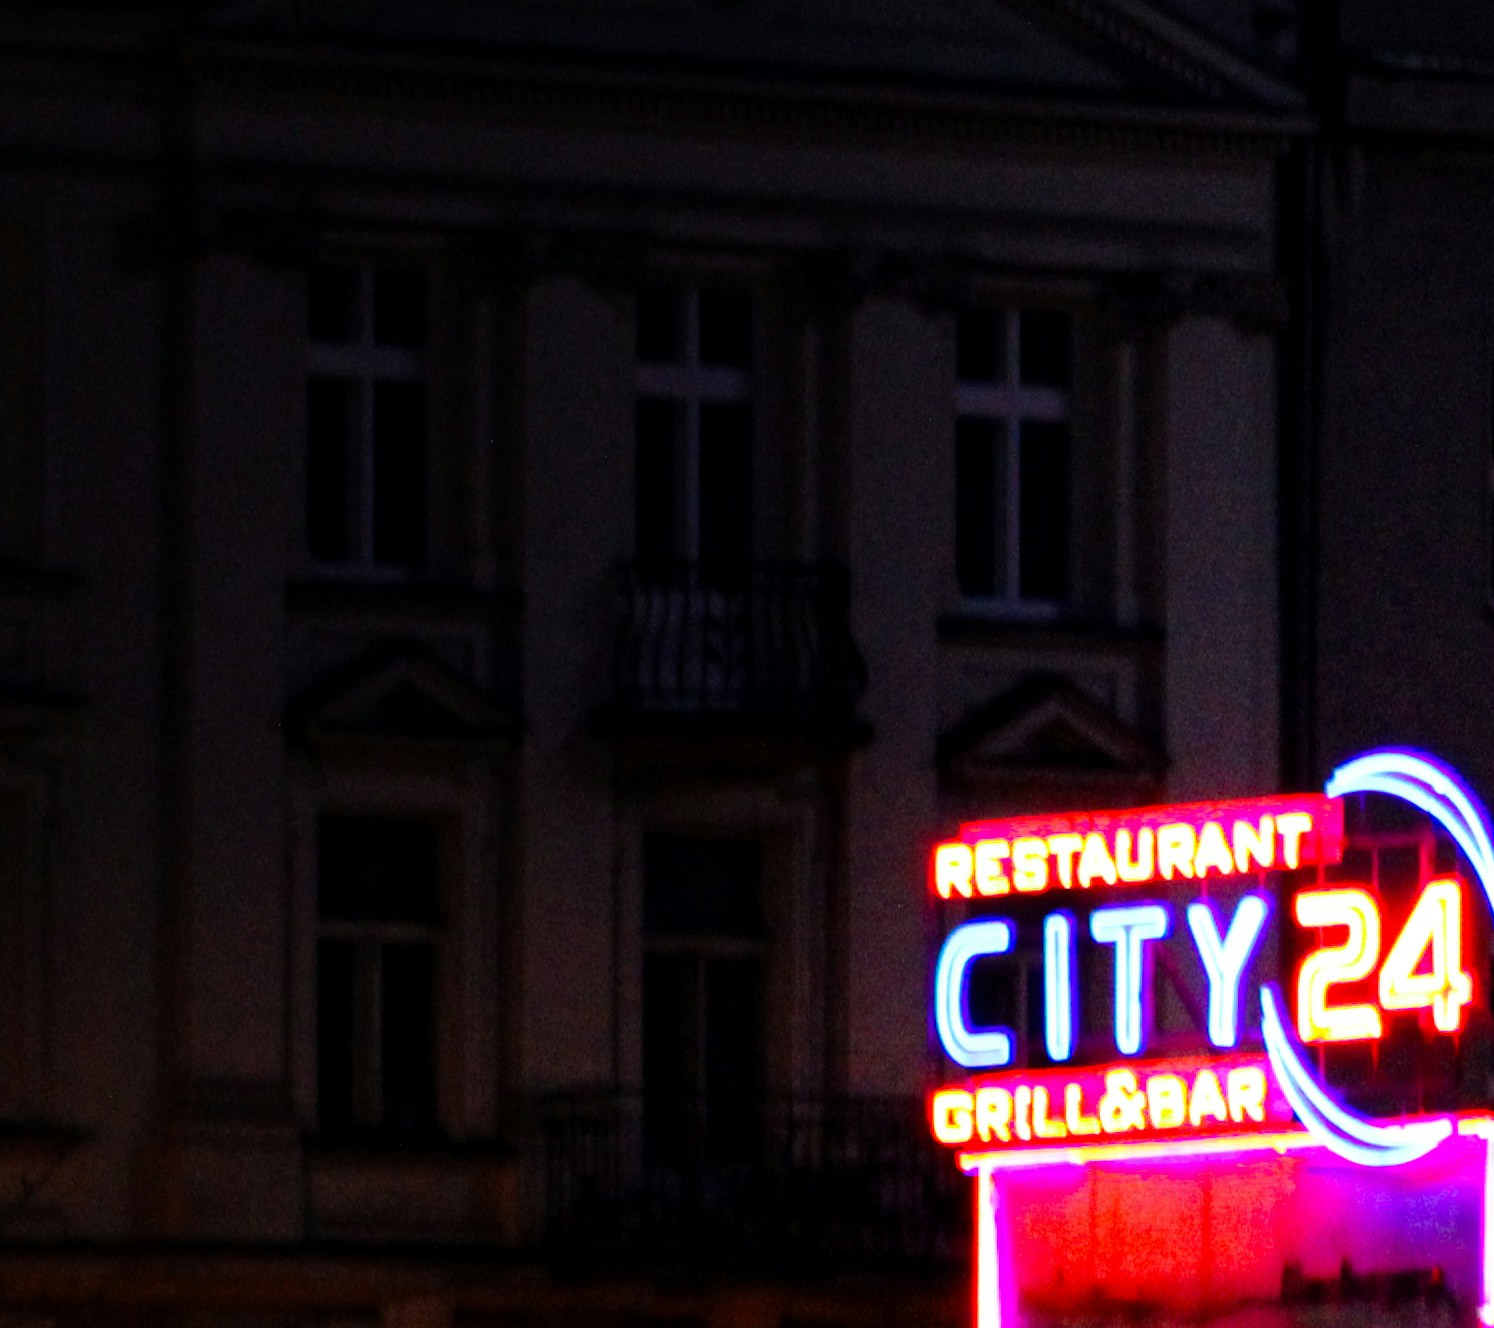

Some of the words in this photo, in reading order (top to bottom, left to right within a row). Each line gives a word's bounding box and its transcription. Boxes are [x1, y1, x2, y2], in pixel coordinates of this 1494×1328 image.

[934, 811, 1313, 900] RESTAURANT
[934, 894, 1268, 1068] CITY
[1295, 875, 1474, 1046] 24
[931, 1066, 1268, 1146] GRILL&BAR
